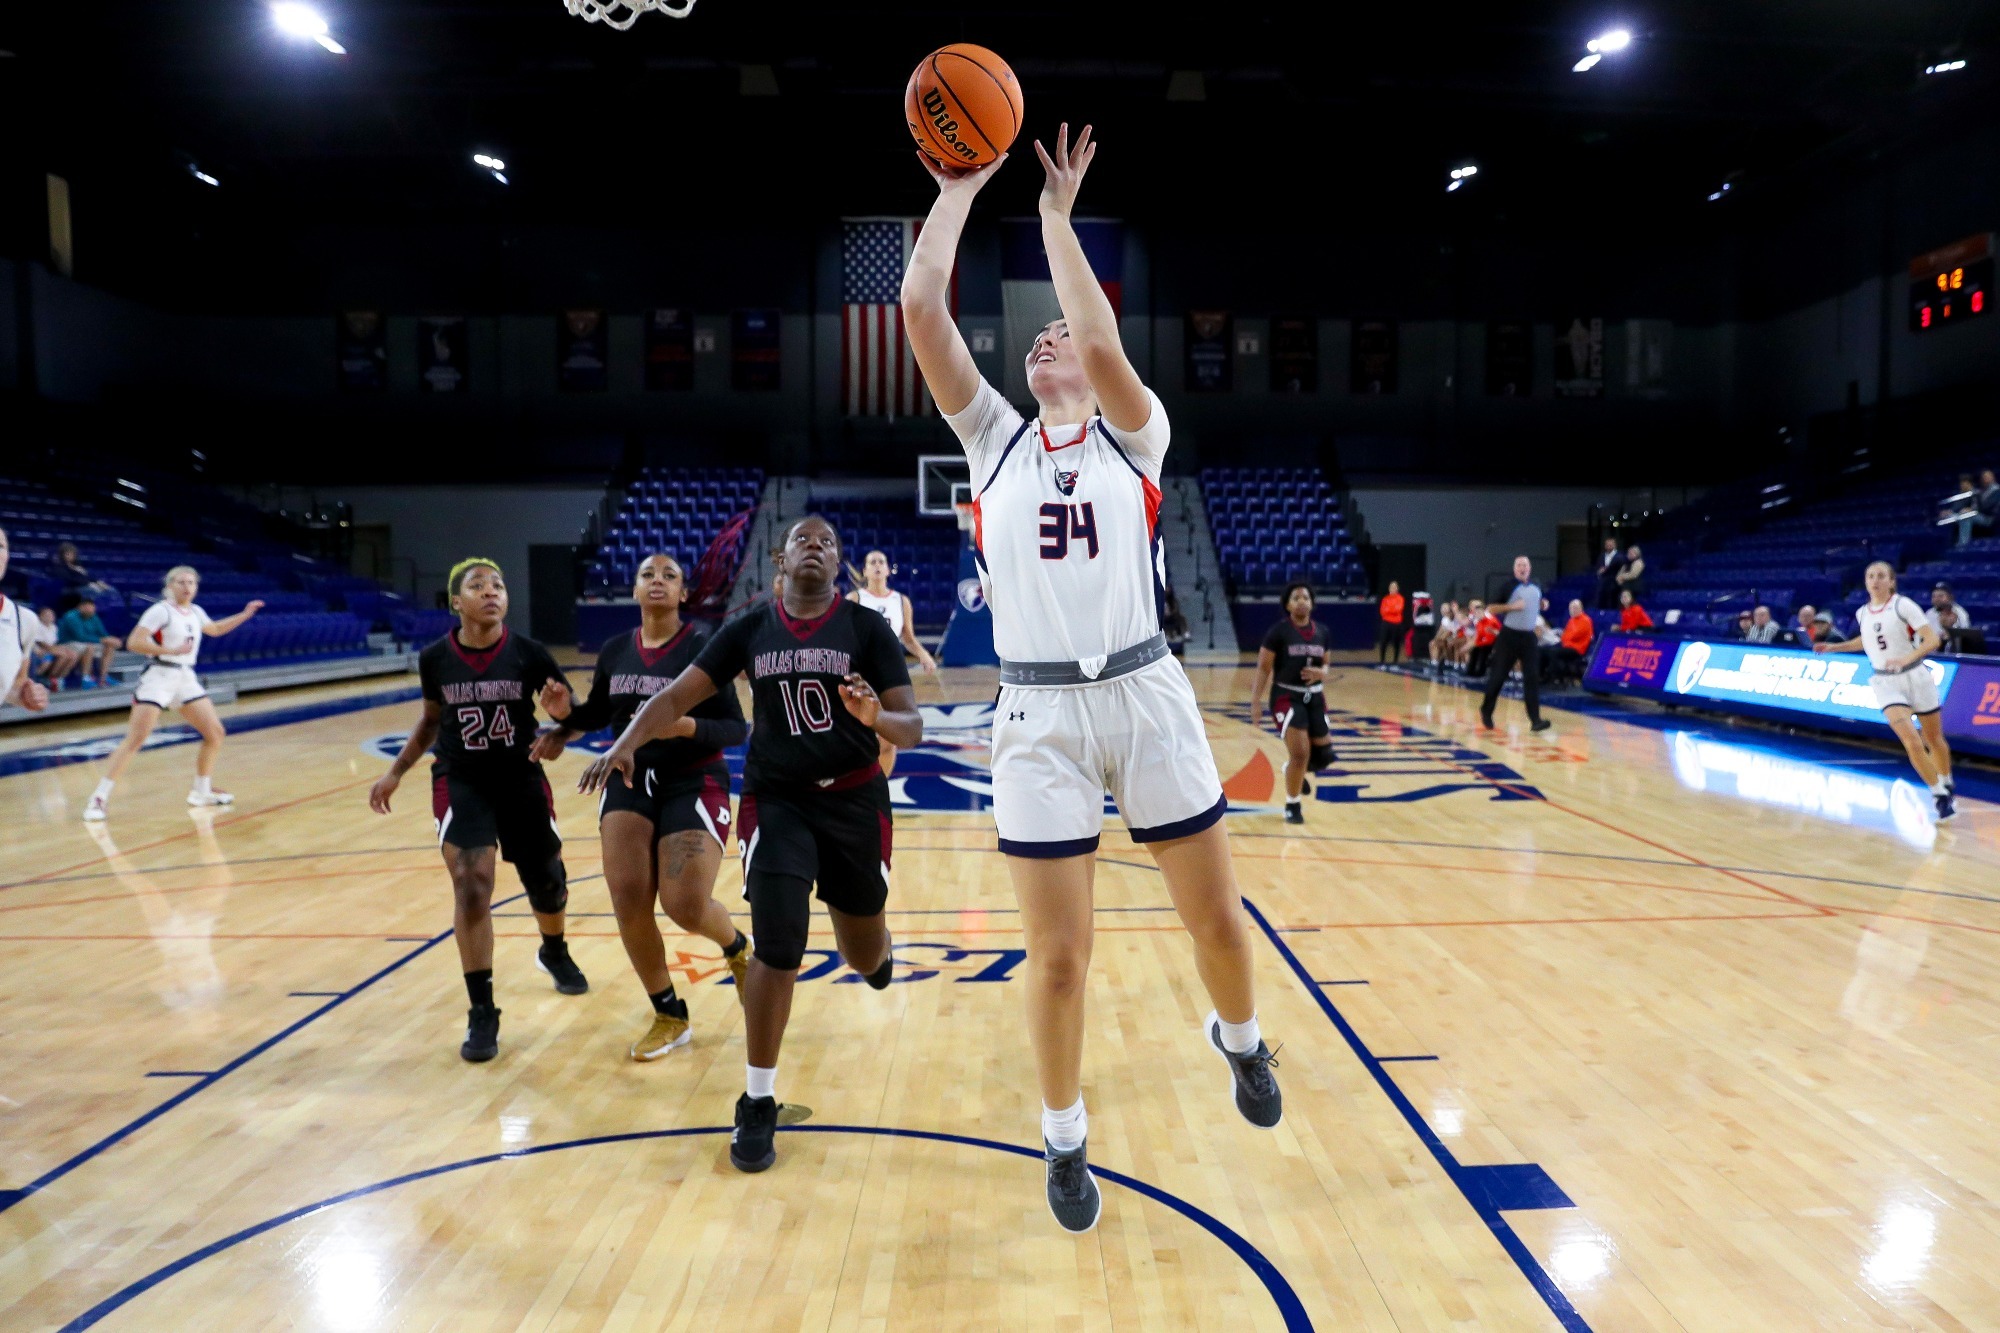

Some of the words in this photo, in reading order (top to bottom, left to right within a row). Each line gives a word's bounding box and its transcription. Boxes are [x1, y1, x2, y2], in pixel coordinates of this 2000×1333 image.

[922, 86, 979, 161] Wilson
[1039, 501, 1099, 561] 34
[457, 704, 516, 750] 24
[778, 679, 834, 737] 10
